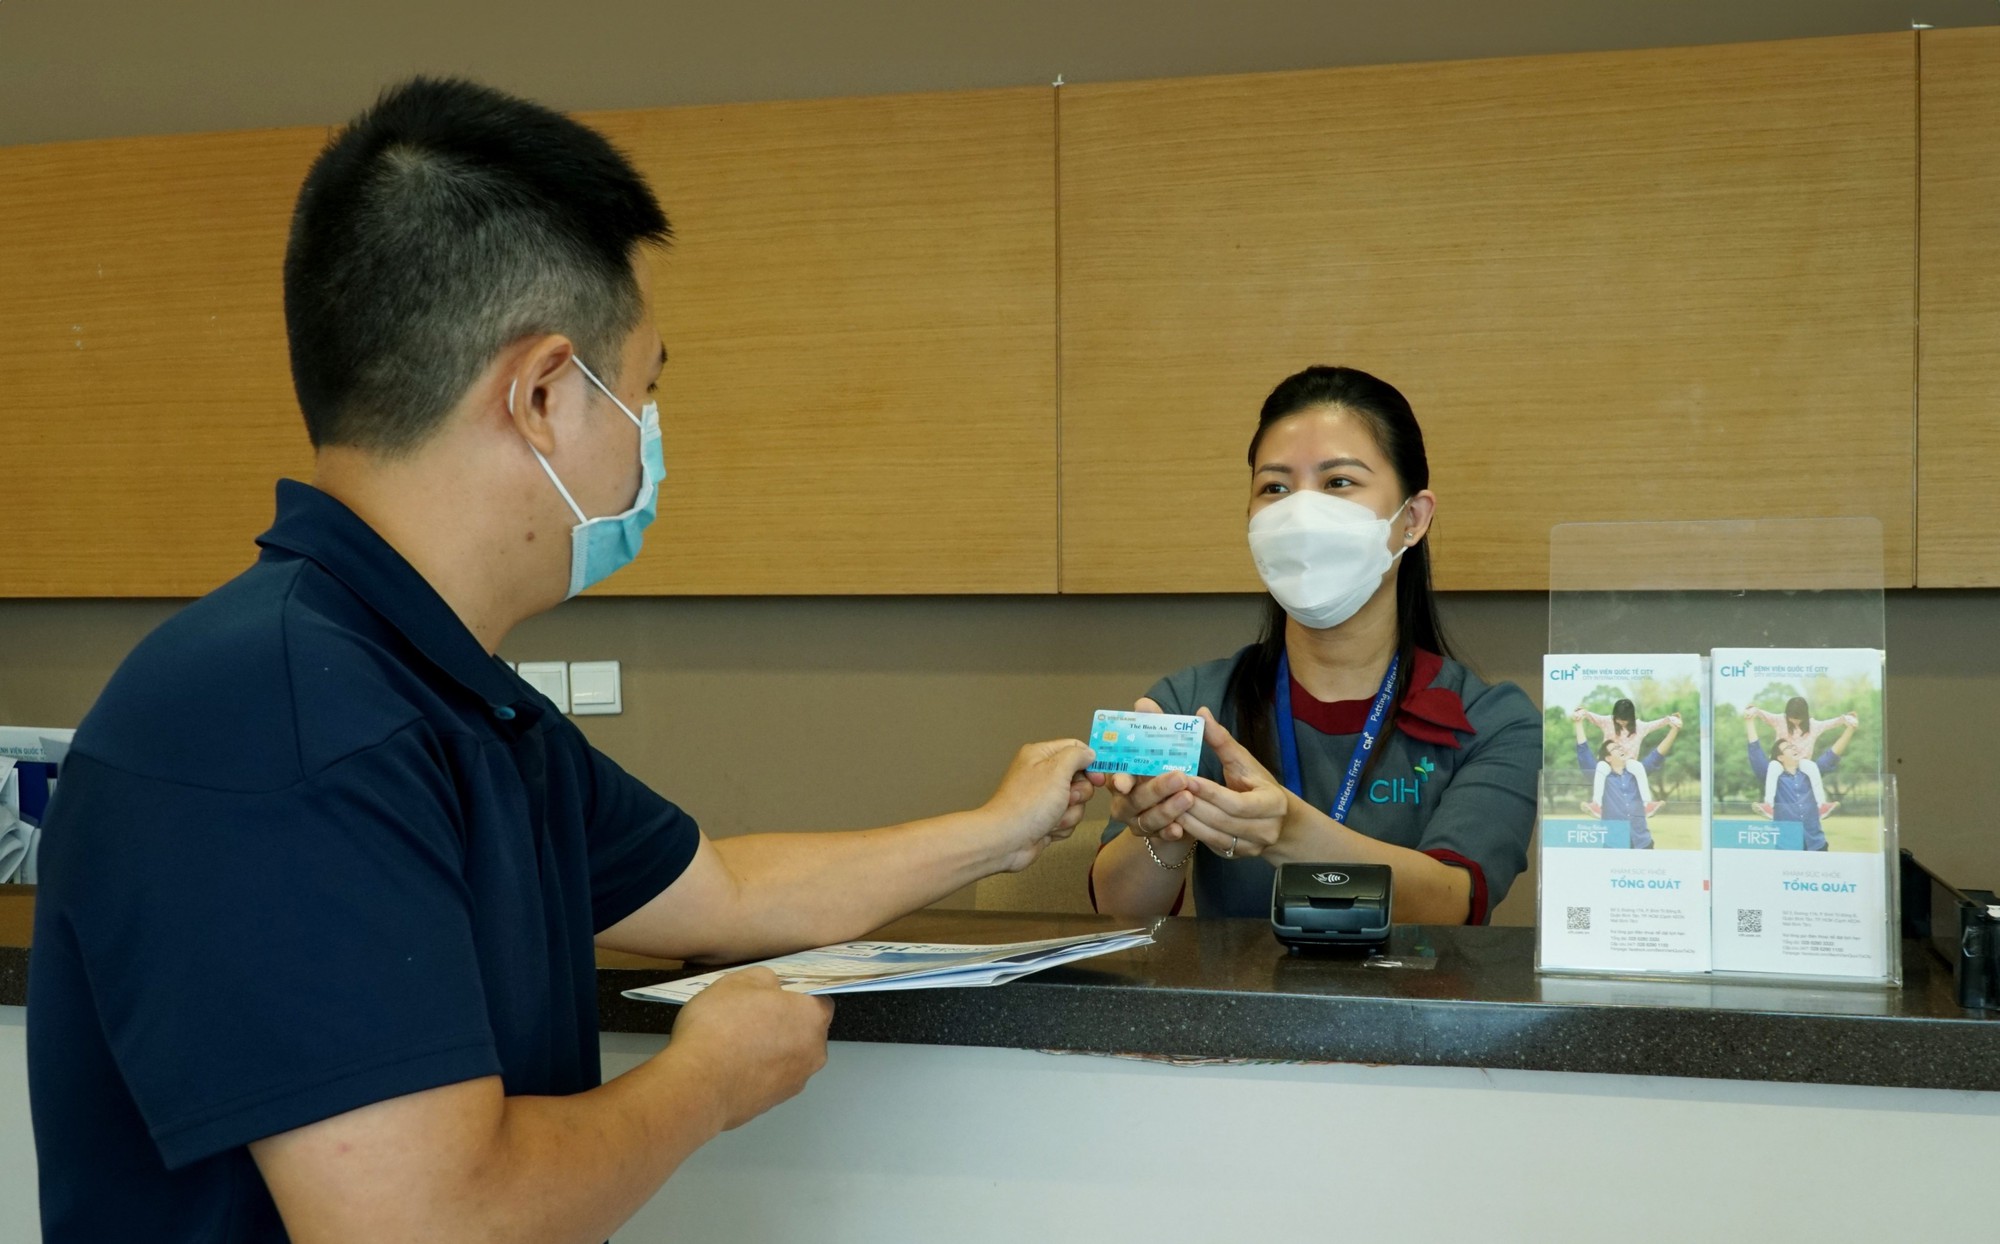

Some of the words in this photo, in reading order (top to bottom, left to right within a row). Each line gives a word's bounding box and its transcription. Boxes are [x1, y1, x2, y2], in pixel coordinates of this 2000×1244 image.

[1550, 669, 1575, 681] CIH
[1720, 665, 1746, 677] CIH
[1370, 693, 1390, 722] Putting
[1174, 721, 1194, 731] CIH
[1362, 735, 1374, 750] CIH
[1338, 779, 1355, 812] patients
[1348, 759, 1361, 777] first
[1369, 778, 1420, 805] CIH
[1567, 830, 1608, 844] FIRST
[1738, 831, 1781, 845] FIRST
[1610, 875, 1645, 889] TỔNG
[1647, 878, 1681, 890] QUÁT
[1783, 877, 1818, 892] TỔNG
[1821, 879, 1857, 893] QUÁT
